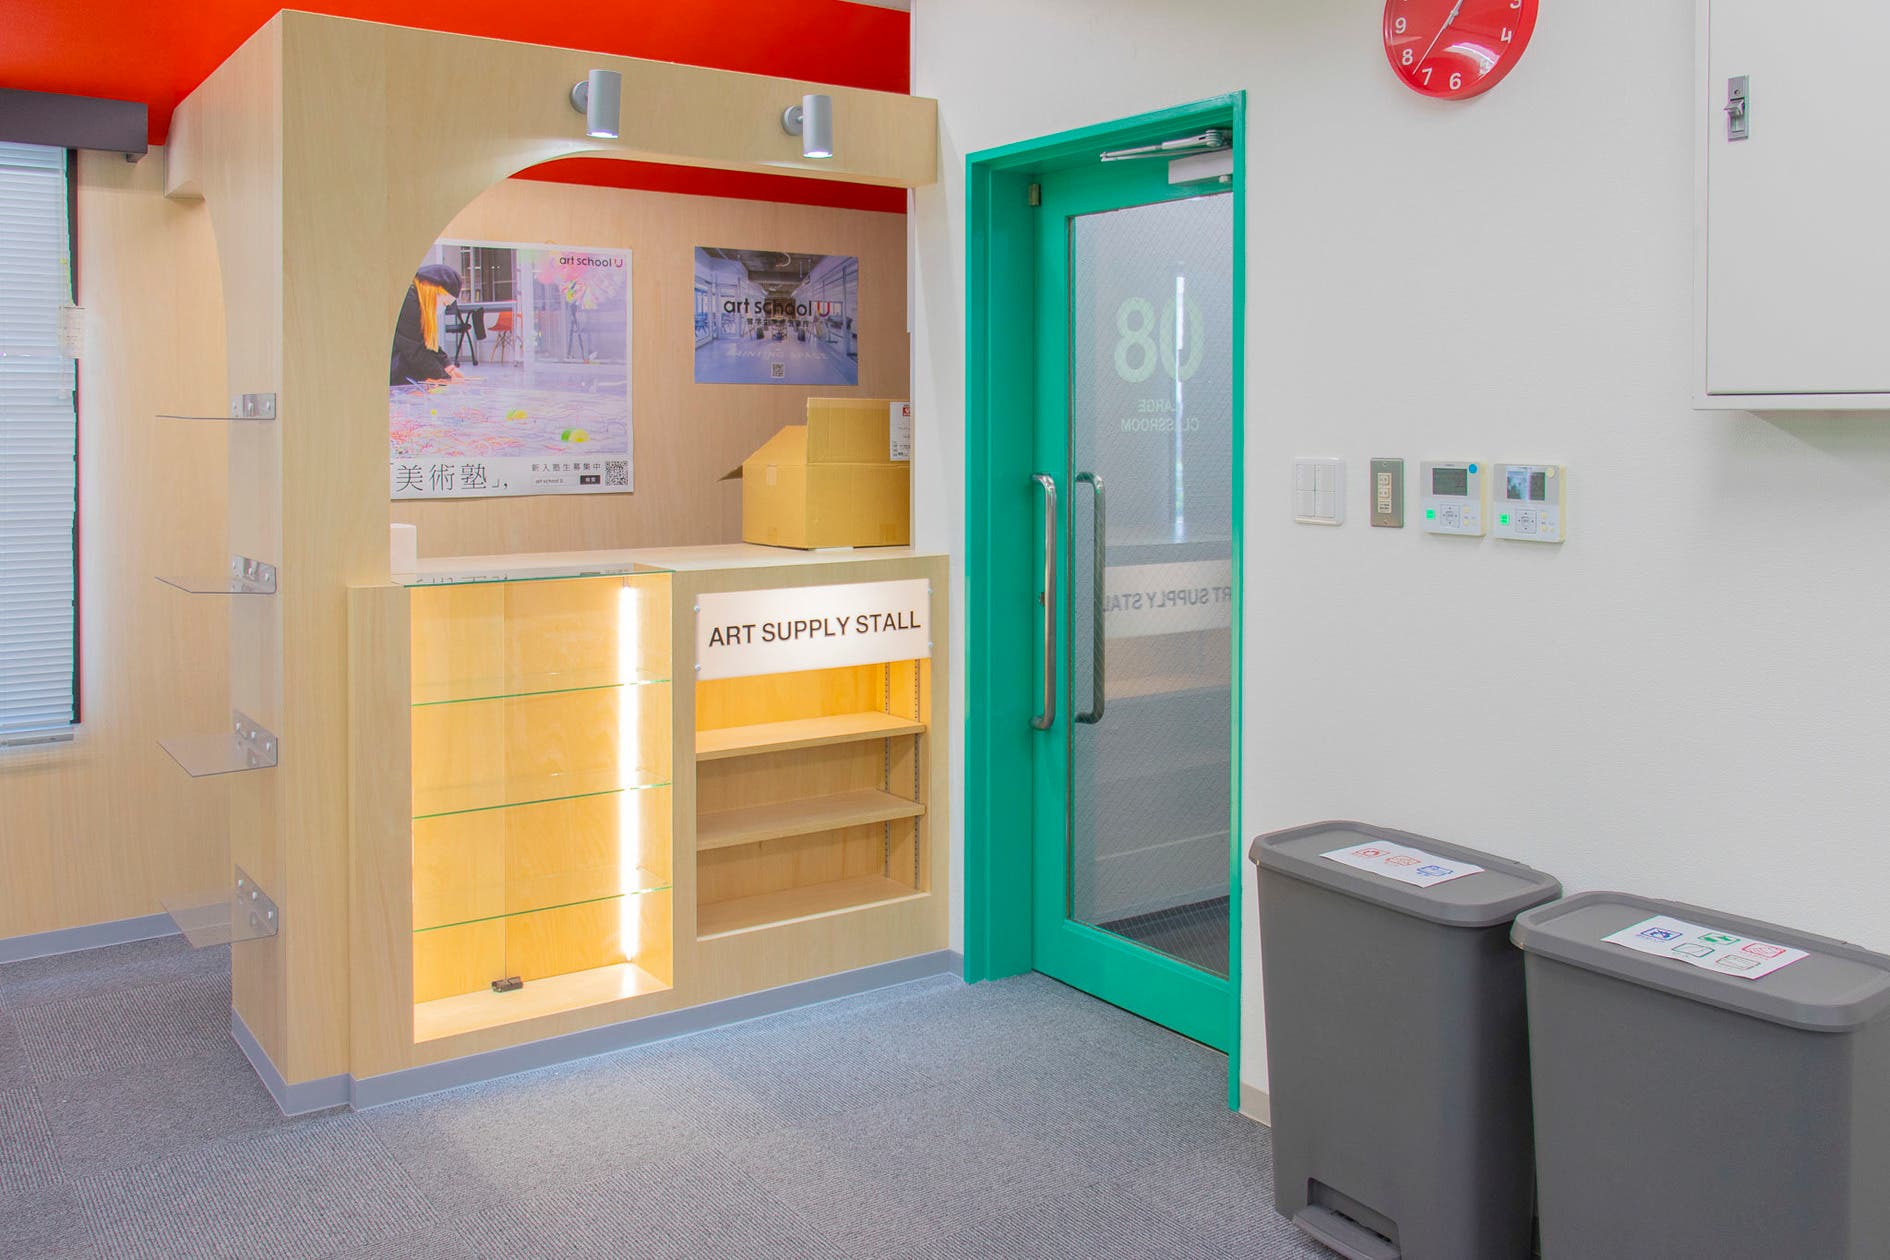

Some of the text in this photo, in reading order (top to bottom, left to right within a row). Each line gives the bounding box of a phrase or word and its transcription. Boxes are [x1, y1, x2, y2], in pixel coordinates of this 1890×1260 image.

[1395, 17, 1407, 34] 9
[1500, 27, 1512, 44] 4
[1402, 48, 1413, 66] 8
[1421, 67, 1433, 86] 7
[1449, 72, 1462, 90] 6
[559, 256, 574, 265] art
[576, 256, 612, 267] school
[723, 298, 830, 317] art school U
[708, 611, 921, 648] ART SUPPLY STALL
